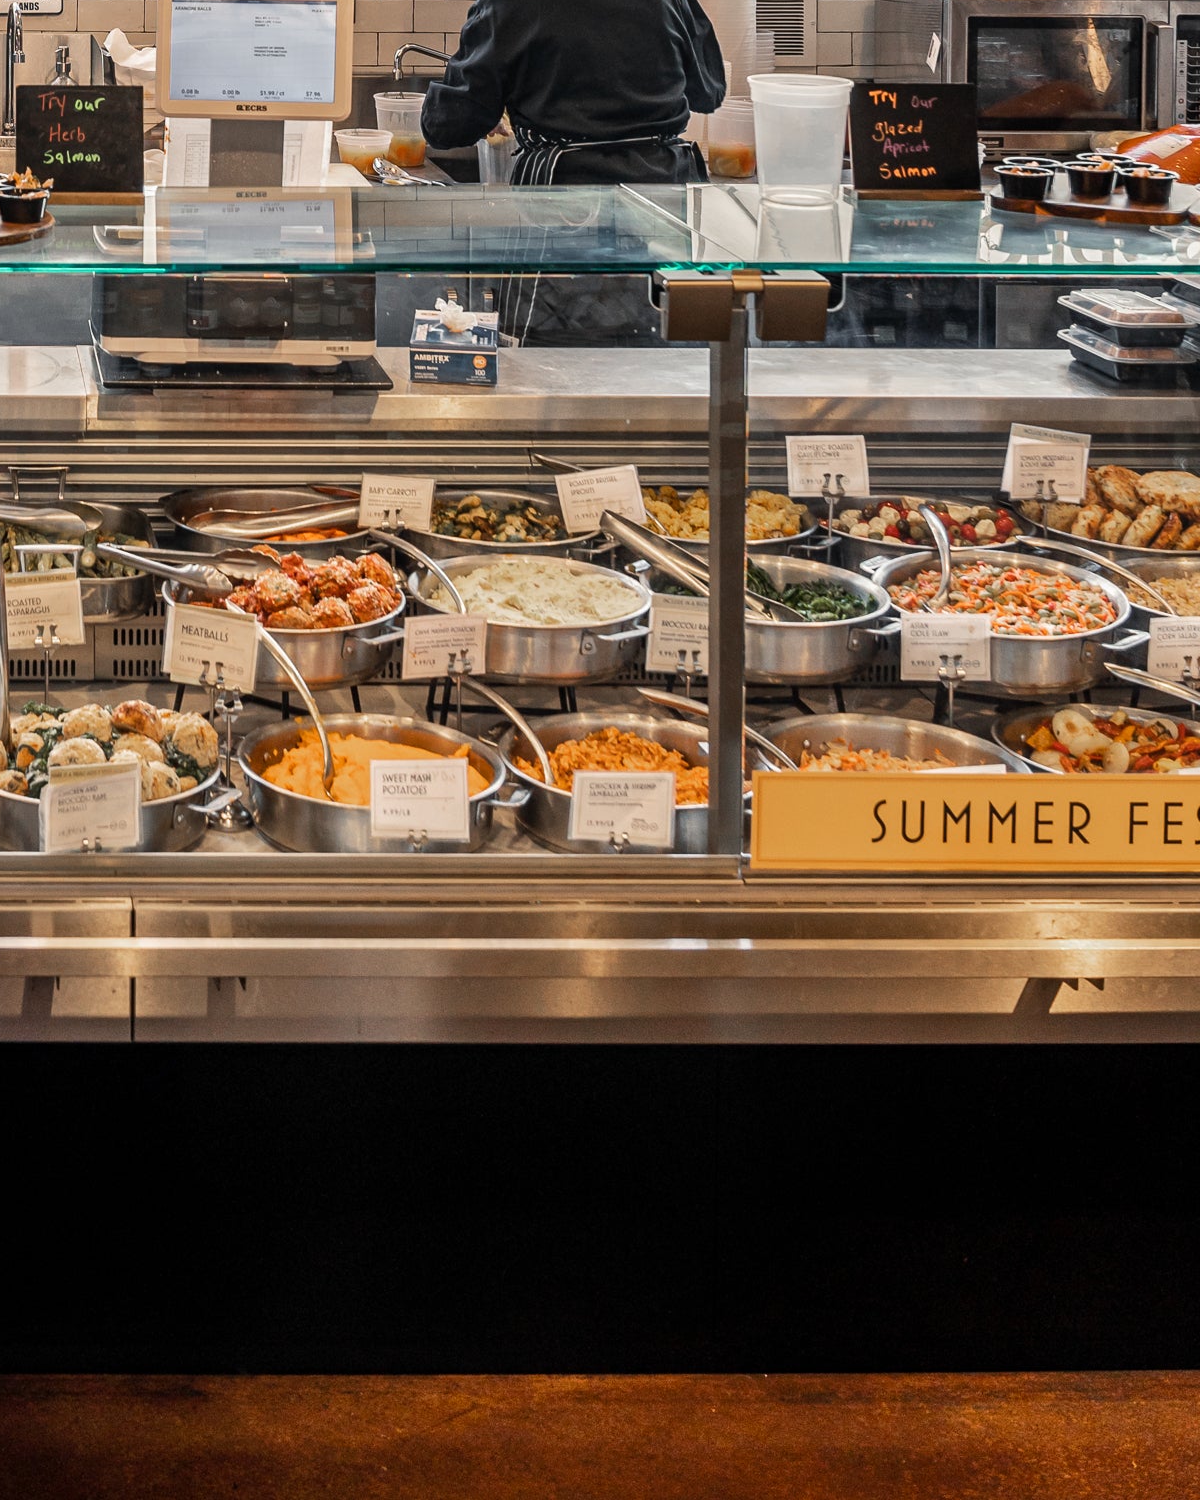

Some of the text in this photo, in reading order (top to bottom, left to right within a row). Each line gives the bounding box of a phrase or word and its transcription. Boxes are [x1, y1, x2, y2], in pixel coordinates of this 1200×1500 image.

[18, 2, 40, 11] ANDS
[38, 92, 106, 116] Try our
[868, 89, 898, 109] Try
[48, 127, 86, 143] Herb
[872, 119, 923, 142] glazed
[883, 137, 931, 156] Apricot
[43, 150, 101, 165] Salmon
[879, 162, 937, 180] Salmon
[414, 353, 450, 364] AMBITEX
[7, 597, 41, 607] ROASTED
[8, 605, 50, 616] ASPARAGUS
[181, 624, 229, 642] MEATBALLS
[382, 773, 432, 782] SWEET MASH
[382, 784, 427, 795] POTATOES
[871, 799, 1091, 844] SUMMER
